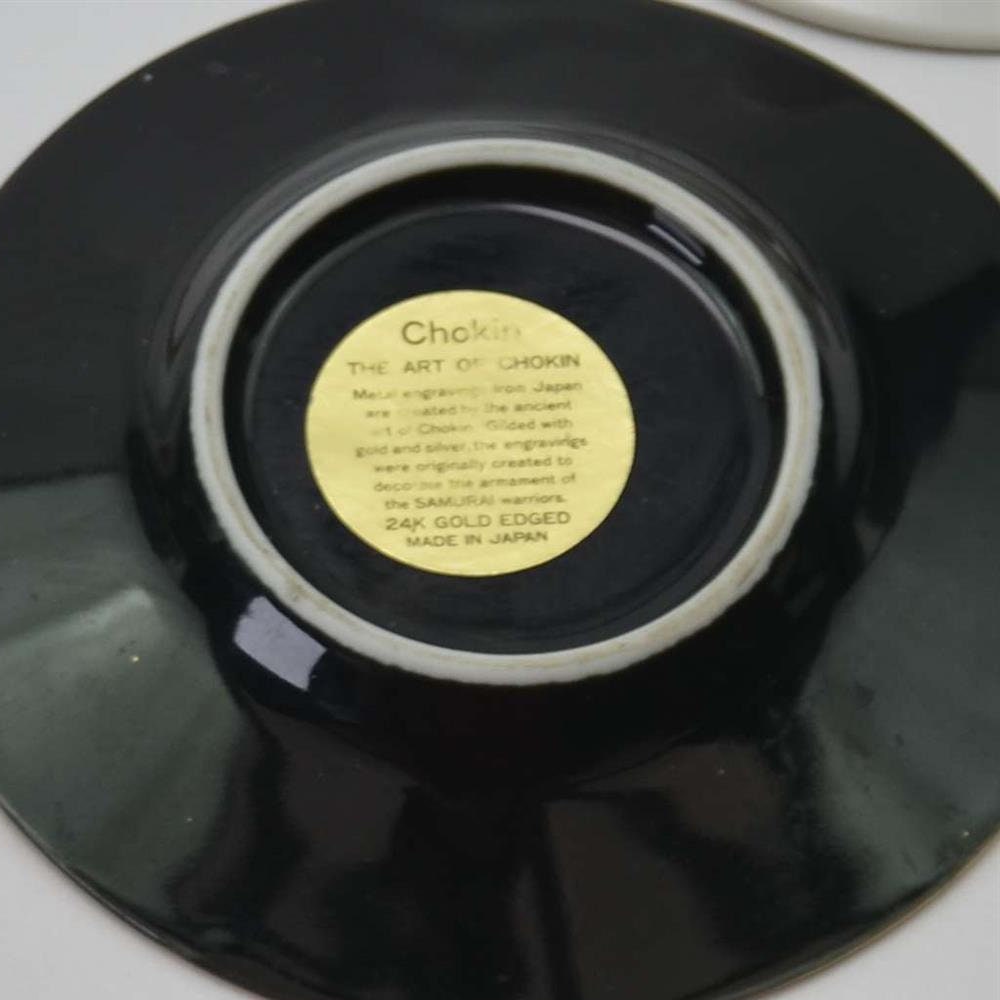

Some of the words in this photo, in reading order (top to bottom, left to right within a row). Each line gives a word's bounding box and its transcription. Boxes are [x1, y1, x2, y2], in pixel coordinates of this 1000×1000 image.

[347, 361, 390, 377] THE
[403, 358, 446, 375] ART
[498, 354, 581, 371] CHOKIN
[533, 380, 583, 395] Japan
[365, 408, 391, 419] are
[484, 402, 509, 414] the
[513, 400, 573, 413] ancient
[541, 417, 573, 430] with
[392, 443, 421, 455] and
[473, 440, 497, 452] the
[504, 435, 588, 452] engravings
[374, 462, 410, 474] were
[415, 458, 485, 475] originally
[492, 455, 553, 469] created
[557, 455, 574, 467] to
[448, 478, 474, 490] the
[479, 474, 556, 489] armament
[562, 472, 577, 485] of
[385, 498, 410, 511] the
[415, 495, 495, 510] SAMURAI
[385, 516, 427, 532] 24K
[434, 514, 493, 529] GOLD
[500, 511, 572, 526] EDGED
[406, 534, 459, 548] MADE
[464, 533, 484, 546] IN
[489, 530, 549, 545] JAPAN
